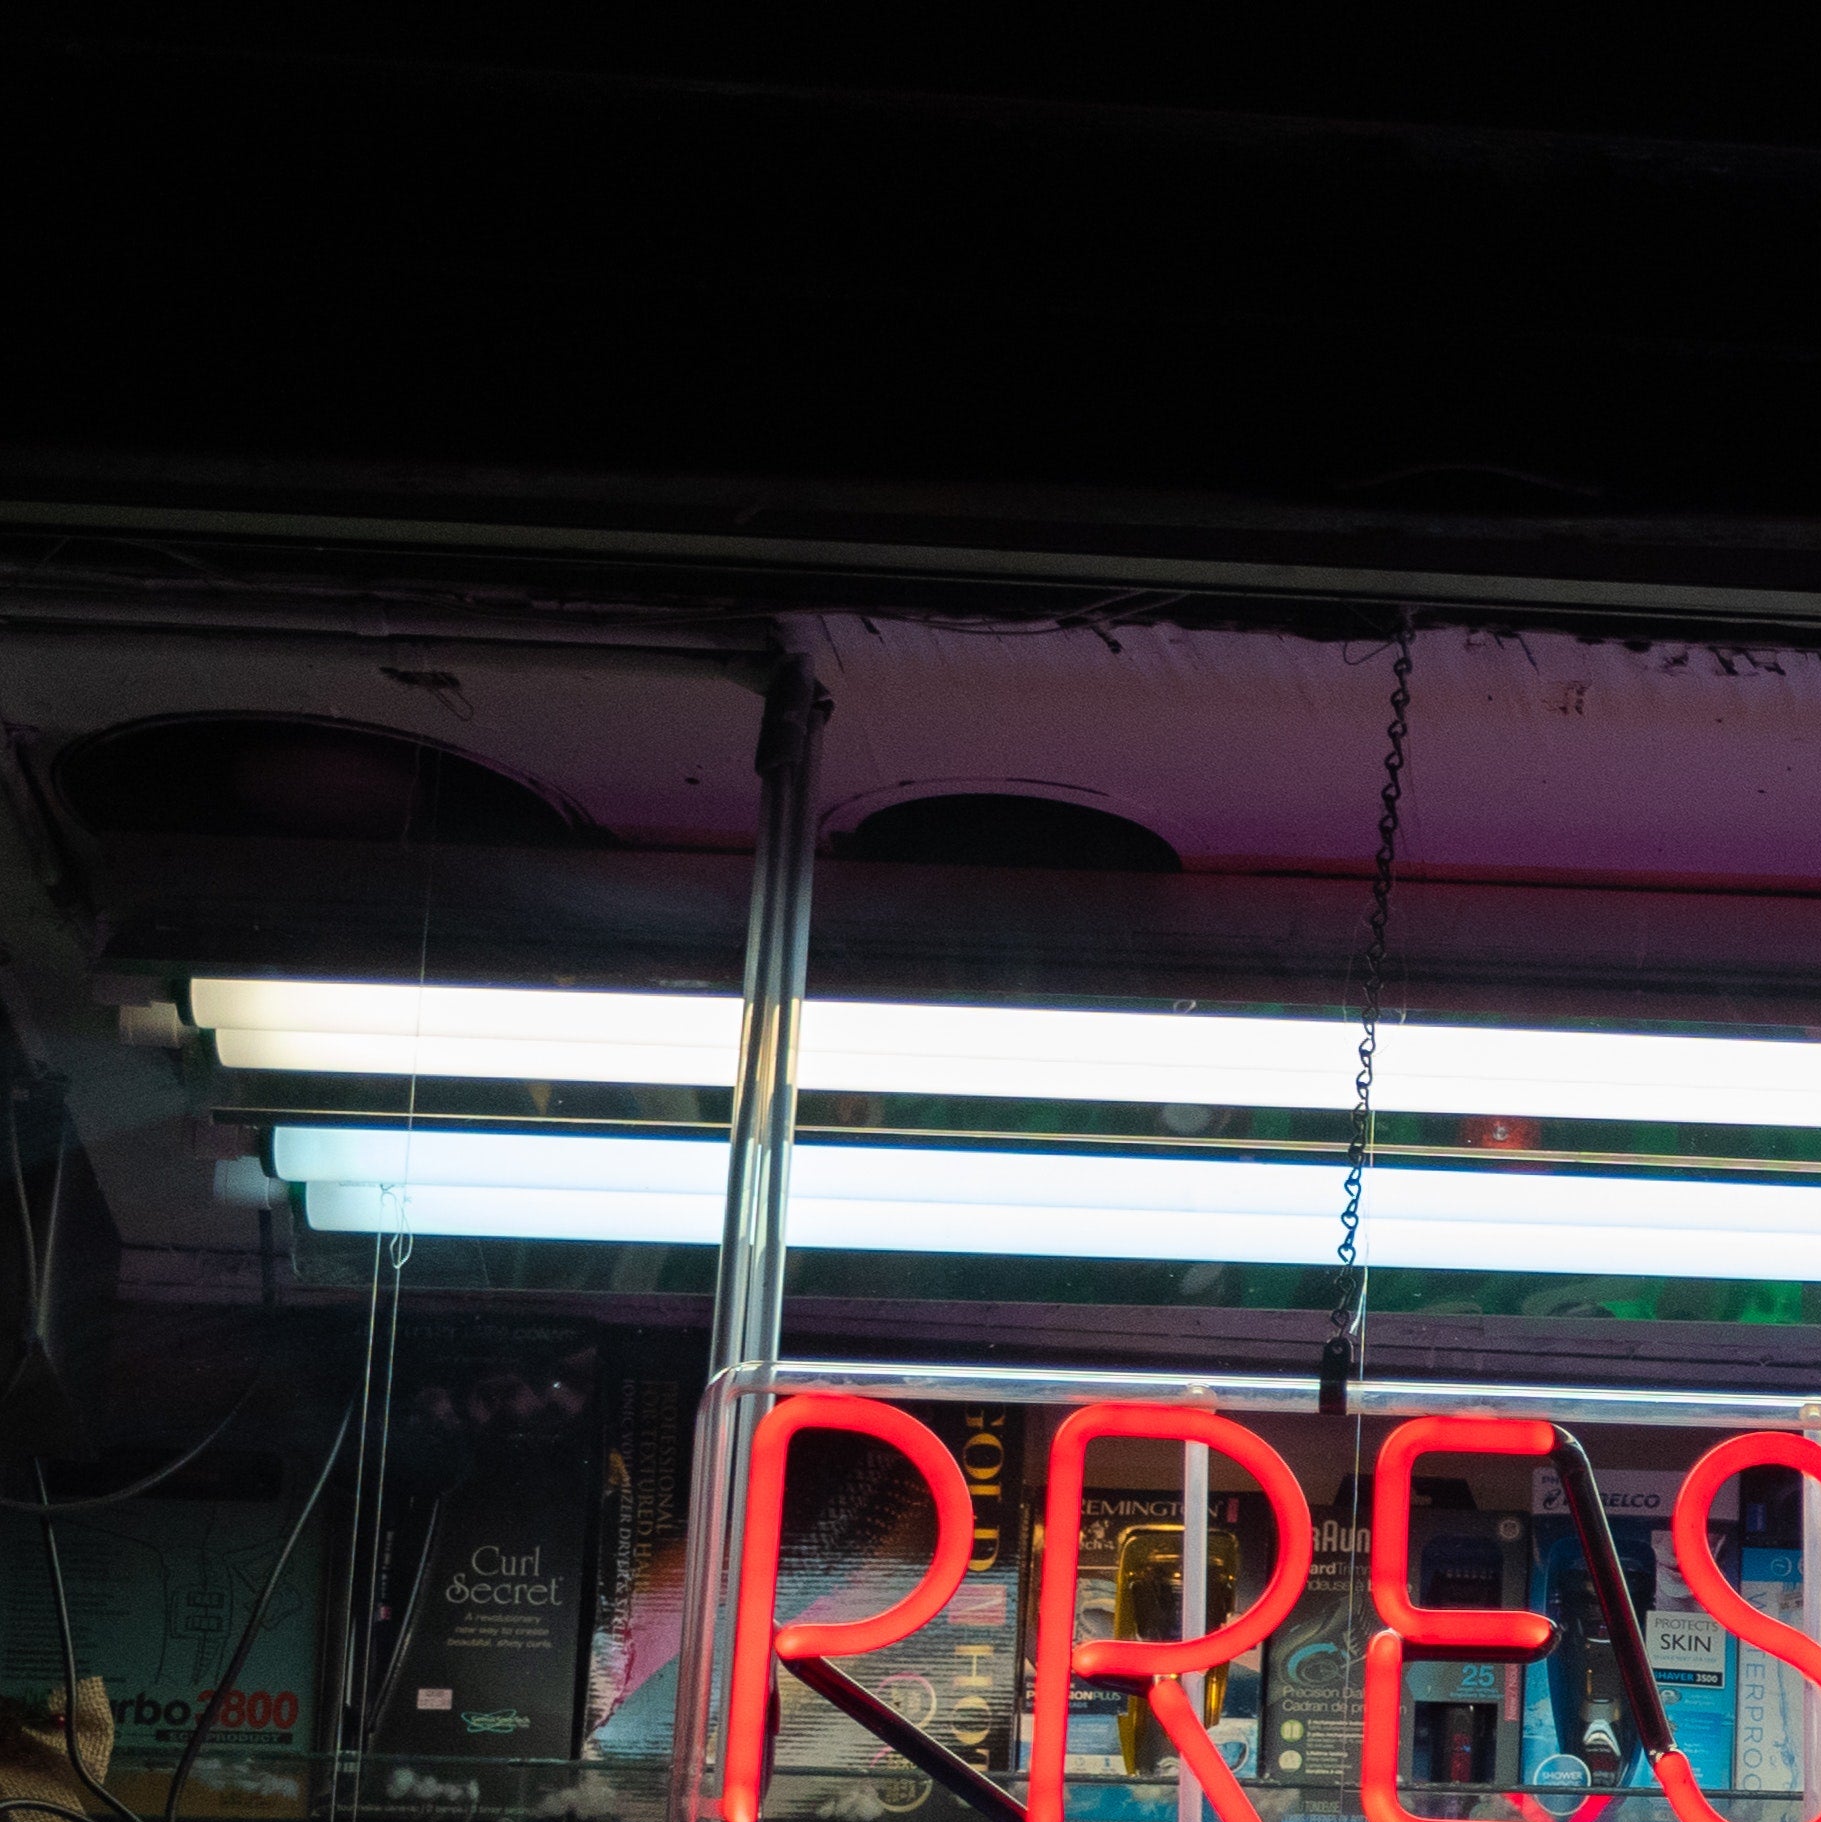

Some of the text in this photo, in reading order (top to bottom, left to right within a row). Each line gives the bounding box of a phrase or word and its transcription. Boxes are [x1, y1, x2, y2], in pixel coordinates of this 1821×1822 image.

[471, 1545, 540, 1577] Curl
[445, 1573, 562, 1605] Secret
[1654, 1618, 1719, 1631] PROTECTS
[1660, 1634, 1711, 1652] SKIN
[1462, 1665, 1495, 1685] 25
[1696, 1672, 1718, 1684] 3500
[1282, 1686, 1334, 1698] Precision
[208, 1732, 281, 1744] PRODUCT
[1541, 1771, 1582, 1781] SHOWER
